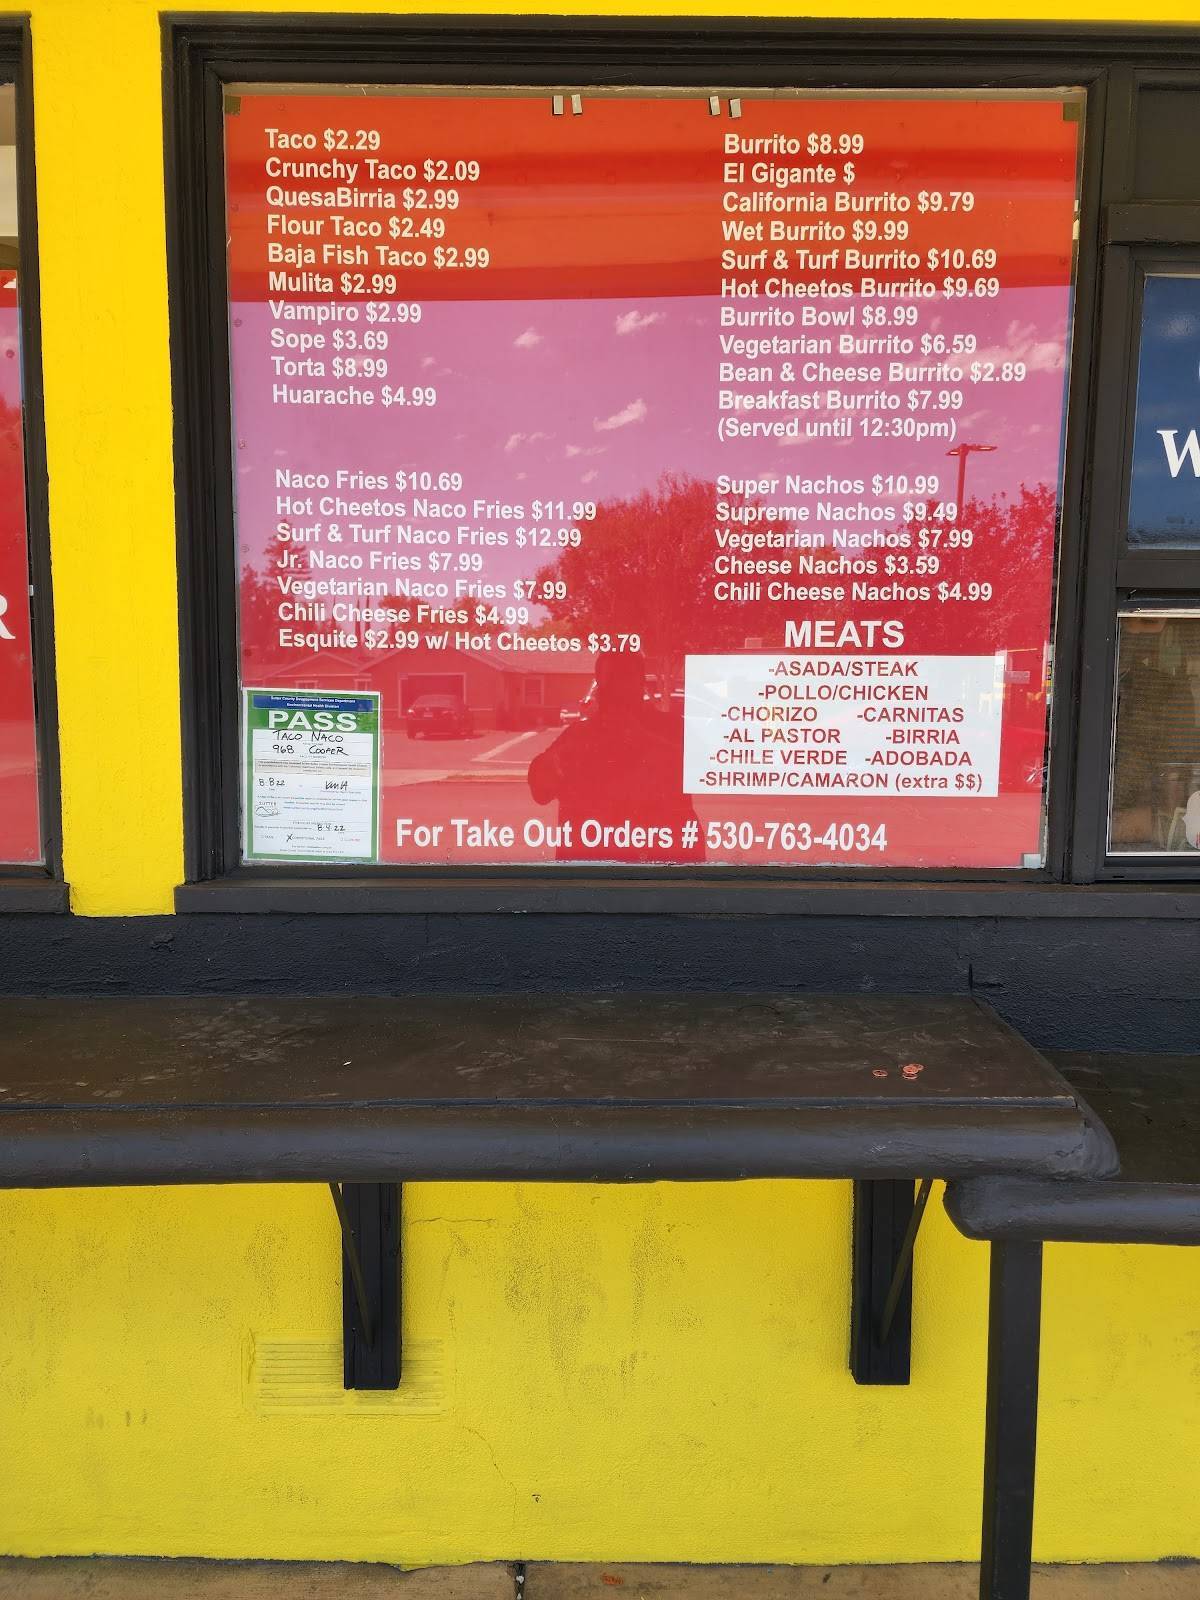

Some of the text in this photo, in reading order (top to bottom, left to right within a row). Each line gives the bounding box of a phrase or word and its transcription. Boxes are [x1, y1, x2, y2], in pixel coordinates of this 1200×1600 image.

[265, 128, 380, 151] Taco $2.29
[725, 133, 863, 156] Burrito $8.99
[266, 157, 479, 184] Crunchy Taco $2.09
[724, 162, 855, 188] El Gigante $
[267, 186, 459, 211] QuesaBirria $2.99
[723, 191, 974, 213] California Burrito $9.79
[268, 215, 445, 239] Flour Taco $2.49
[722, 219, 908, 242] Wet Burrito $9.99
[269, 243, 489, 269] Baja Fish Taco $2.99
[722, 248, 996, 271] Surf & Turf Burrito $10.69
[269, 271, 396, 295] Mulita $2.99
[721, 276, 999, 300] Hot Cheetos Burrito $9.69
[269, 300, 421, 325] Vampiro $2.99
[721, 305, 917, 328] Burrito Bowl $8.99
[271, 328, 388, 353] Sope $3.69
[720, 333, 976, 359] Vegetarian Burrito $6.59
[271, 356, 387, 379] Torta $8.99
[720, 361, 1026, 384] Bean & Cheese Burrito $2.89
[273, 384, 436, 407] Huarache $4.99
[719, 389, 963, 411] Breakfast Burrito $7.99
[718, 418, 956, 441] (Served until 12:30pm)
[276, 469, 462, 492] Naco Fries $10.69
[717, 474, 939, 498] Super Nachos $10.99
[277, 496, 596, 521] Hot Cheetos Naco Fries $11.99
[716, 501, 958, 525] Supreme Nachos $9.49
[277, 523, 581, 548] Surf & Turf Naco Fries $12.99
[715, 528, 973, 552] Vegetarian Nachos $7.99
[277, 550, 482, 572] Jr. Naco Fries $7.99
[715, 553, 939, 576] Cheese Nachos $3.59
[278, 576, 567, 601] Vegetarian Naco Fries $7.99
[714, 581, 992, 602] Chili Cheese Nachos $4.99
[278, 603, 530, 627] Chili Cheese Fries $4.99
[279, 629, 640, 654] Esquite $2.99 w/ Hot Cheetos $3.79
[785, 621, 904, 647] MEATS
[768, 660, 919, 677] -ASADA/STEAK
[759, 685, 928, 700] -POLLO/CHICKEN
[268, 710, 357, 732] PASS
[722, 707, 817, 721] -CHORIZO
[857, 707, 963, 722] -CARNITAS
[724, 729, 840, 743] -AL PASTOR
[886, 730, 960, 744] -BIRRIA
[272, 744, 295, 754] 968
[710, 749, 847, 764] -CHILE VERDE
[866, 751, 972, 766] -ADOBADA
[700, 772, 982, 792] -SHRIMP/CAMARON (extra $$)
[397, 819, 887, 851] For Take Out Orders # 530-763-4034
